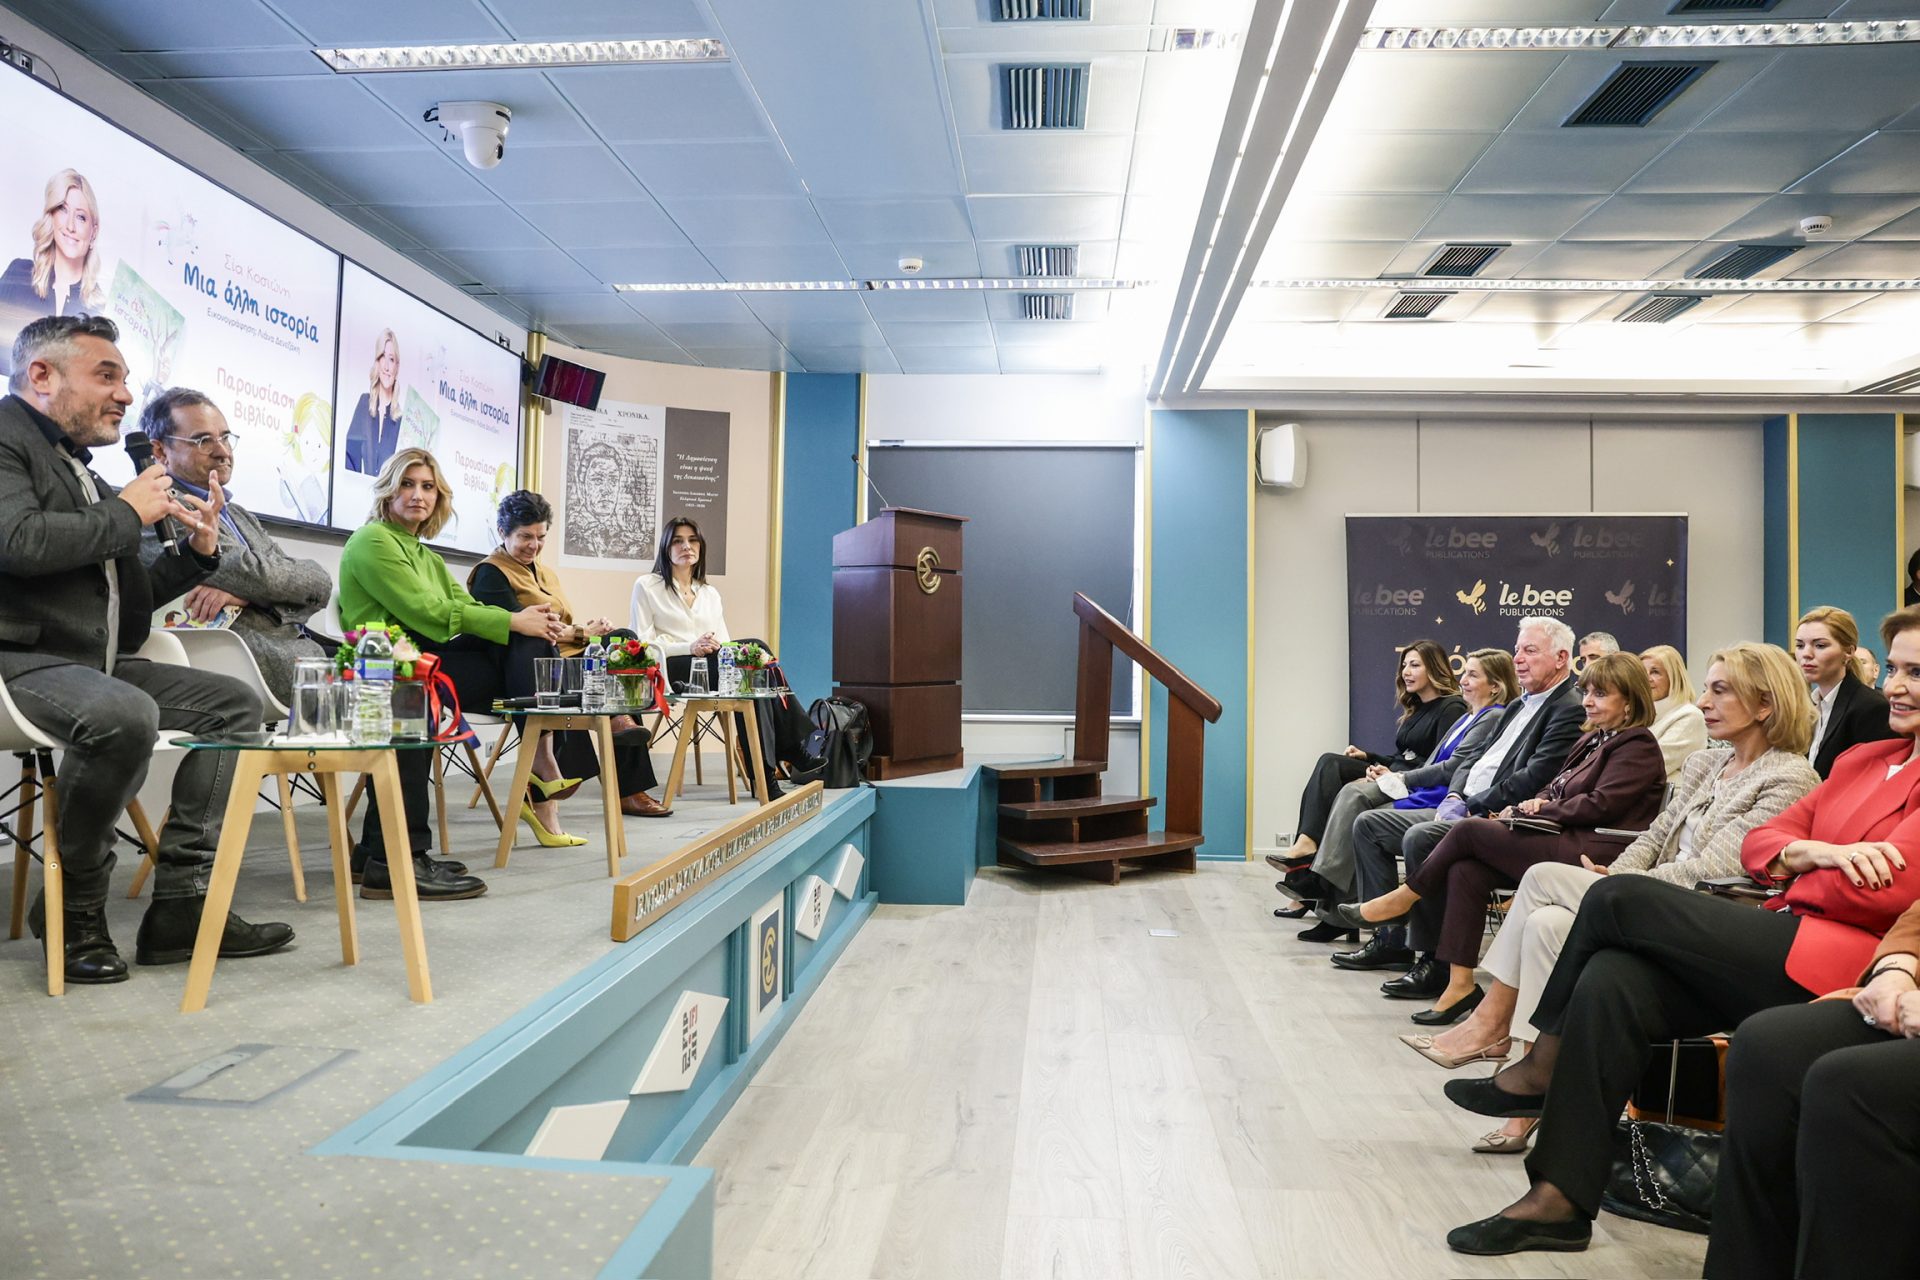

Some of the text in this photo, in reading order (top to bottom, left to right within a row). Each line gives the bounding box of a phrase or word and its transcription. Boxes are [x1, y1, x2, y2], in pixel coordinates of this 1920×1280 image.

[184, 262, 319, 343] Μια άλλη ιστορία
[217, 366, 295, 411] Παρουσίαση
[439, 379, 456, 403] Μια
[459, 387, 478, 412] άλλη
[480, 401, 510, 425] ιστορία
[234, 400, 280, 431] Βιβλίου
[1425, 550, 1490, 560] PUBLICATIONS
[1499, 607, 1565, 617] PUBLICATIONS
